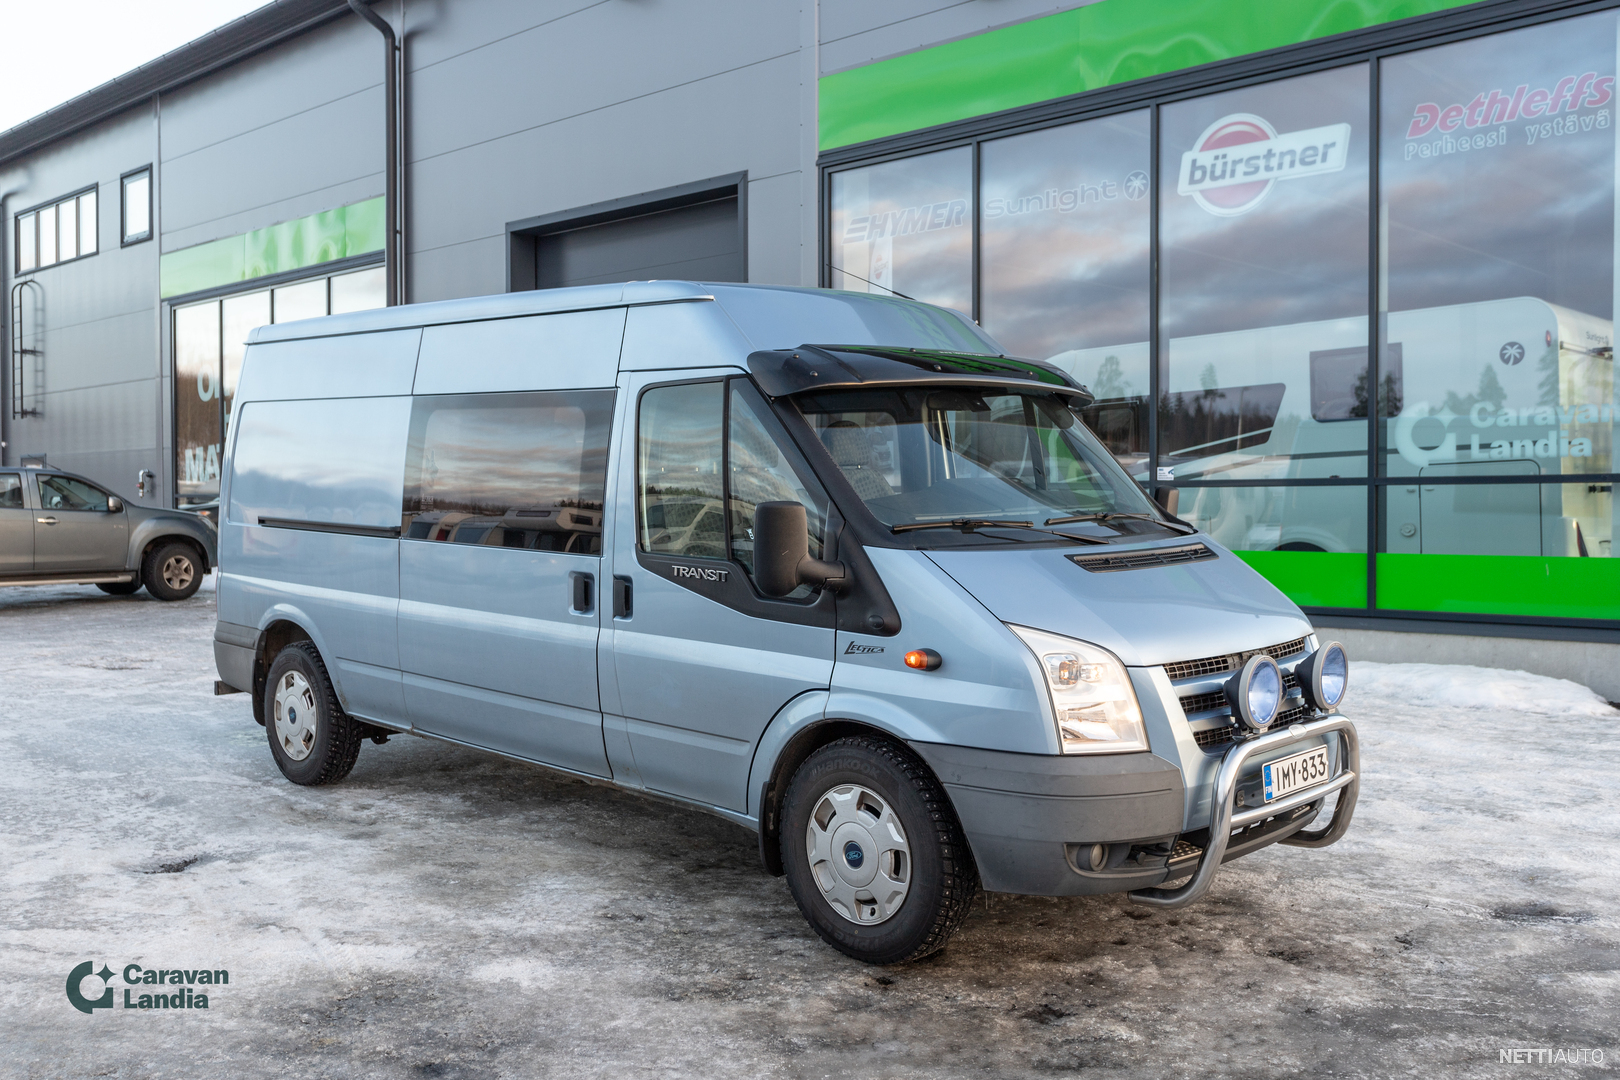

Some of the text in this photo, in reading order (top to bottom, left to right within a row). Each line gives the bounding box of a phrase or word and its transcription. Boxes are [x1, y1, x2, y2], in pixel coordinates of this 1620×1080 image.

[1406, 72, 1615, 139] Dethleffs
[1404, 109, 1610, 160] Perheesi ystävä
[1188, 141, 1337, 186] bürstner
[865, 199, 968, 241] HYMER
[984, 179, 1118, 220] Sunlight
[1469, 401, 1620, 429] Caravan
[1471, 429, 1592, 458] Landia
[672, 565, 728, 582] TRANSIT
[1276, 753, 1326, 791] IMY-833
